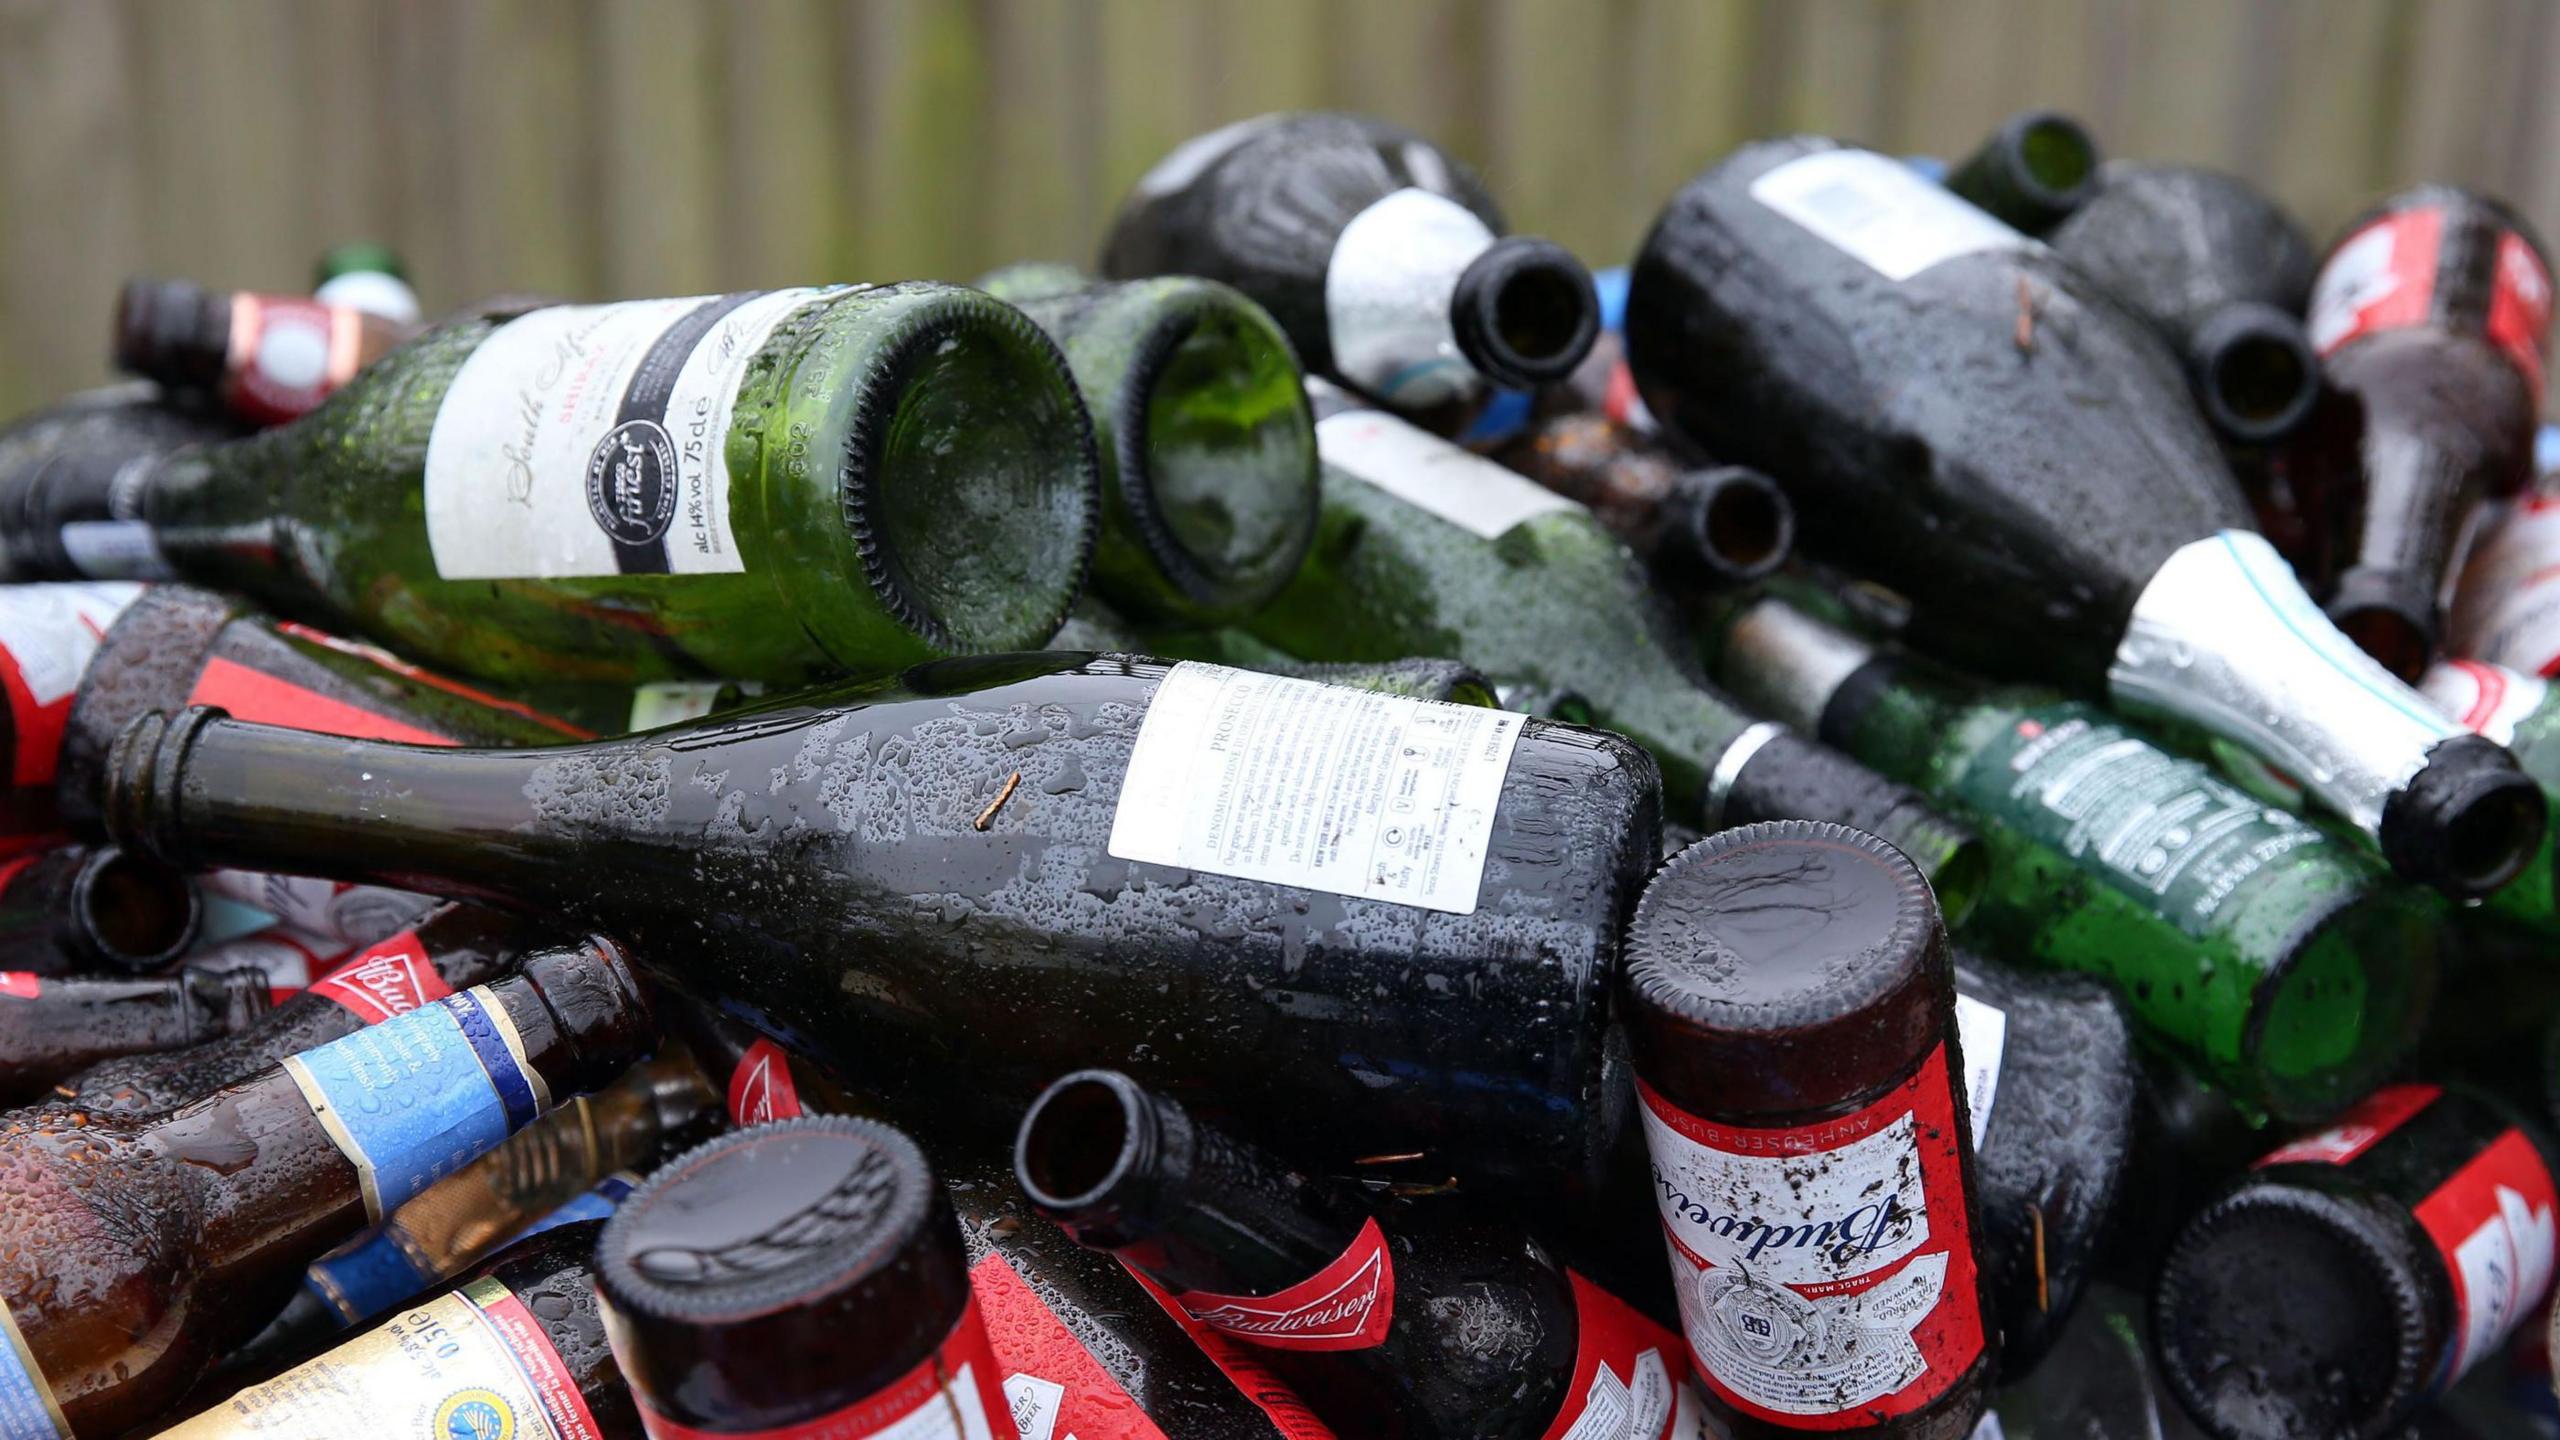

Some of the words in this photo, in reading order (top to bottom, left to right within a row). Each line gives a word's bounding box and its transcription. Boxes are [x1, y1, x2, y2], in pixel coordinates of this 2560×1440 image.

[507, 391, 545, 508] South
[620, 442, 655, 534] finest
[690, 531, 709, 554] alc
[1217, 685, 1250, 751] PROSECCO
[1207, 748, 1241, 849] DENOMINAZIONE
[1654, 1100, 1871, 1148] ANHEUSER-BUSCH
[1650, 1161, 1913, 1263] Budweise
[1194, 1288, 1378, 1338] Budweiser
[557, 1388, 581, 1423] fermer
[1016, 1400, 1042, 1431] BEER
